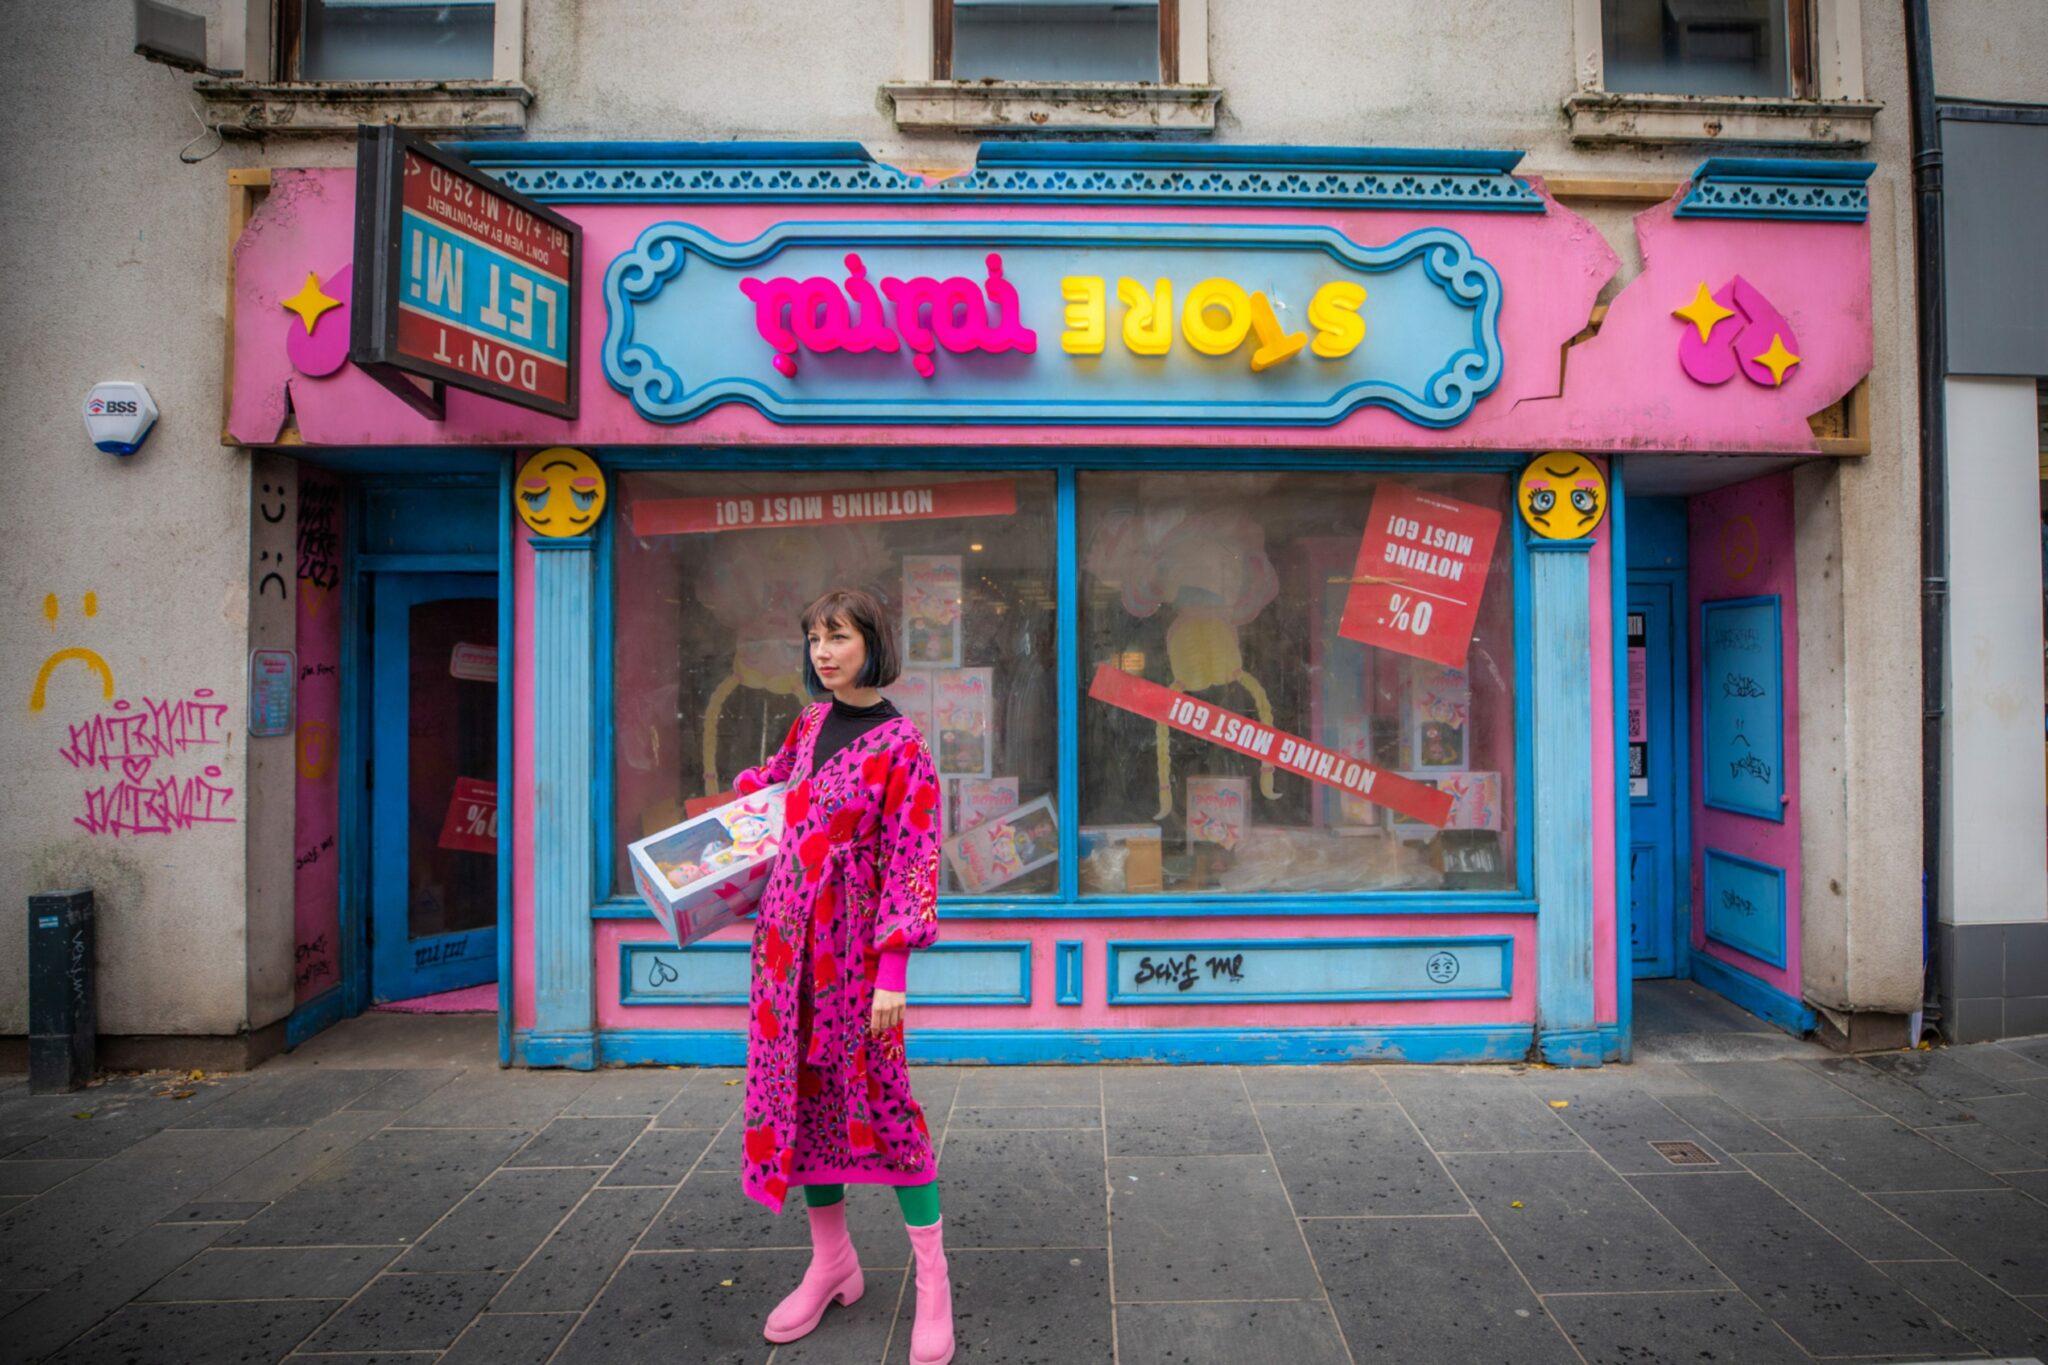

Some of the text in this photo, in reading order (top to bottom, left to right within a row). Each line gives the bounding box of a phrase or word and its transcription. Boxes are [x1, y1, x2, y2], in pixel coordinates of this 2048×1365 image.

[426, 195, 548, 265] DON'T VIEW BY APPOINTMENT
[480, 263, 557, 349] LET
[1061, 276, 1368, 371] STORE
[433, 328, 536, 391] DON'T
[106, 401, 138, 413] BSS
[716, 489, 933, 525] NOTHING MUST GO!
[1386, 515, 1474, 557] MUST GO!
[1384, 542, 1464, 582] NOTHING
[1168, 697, 1377, 794] NOTHING MUST GO!
